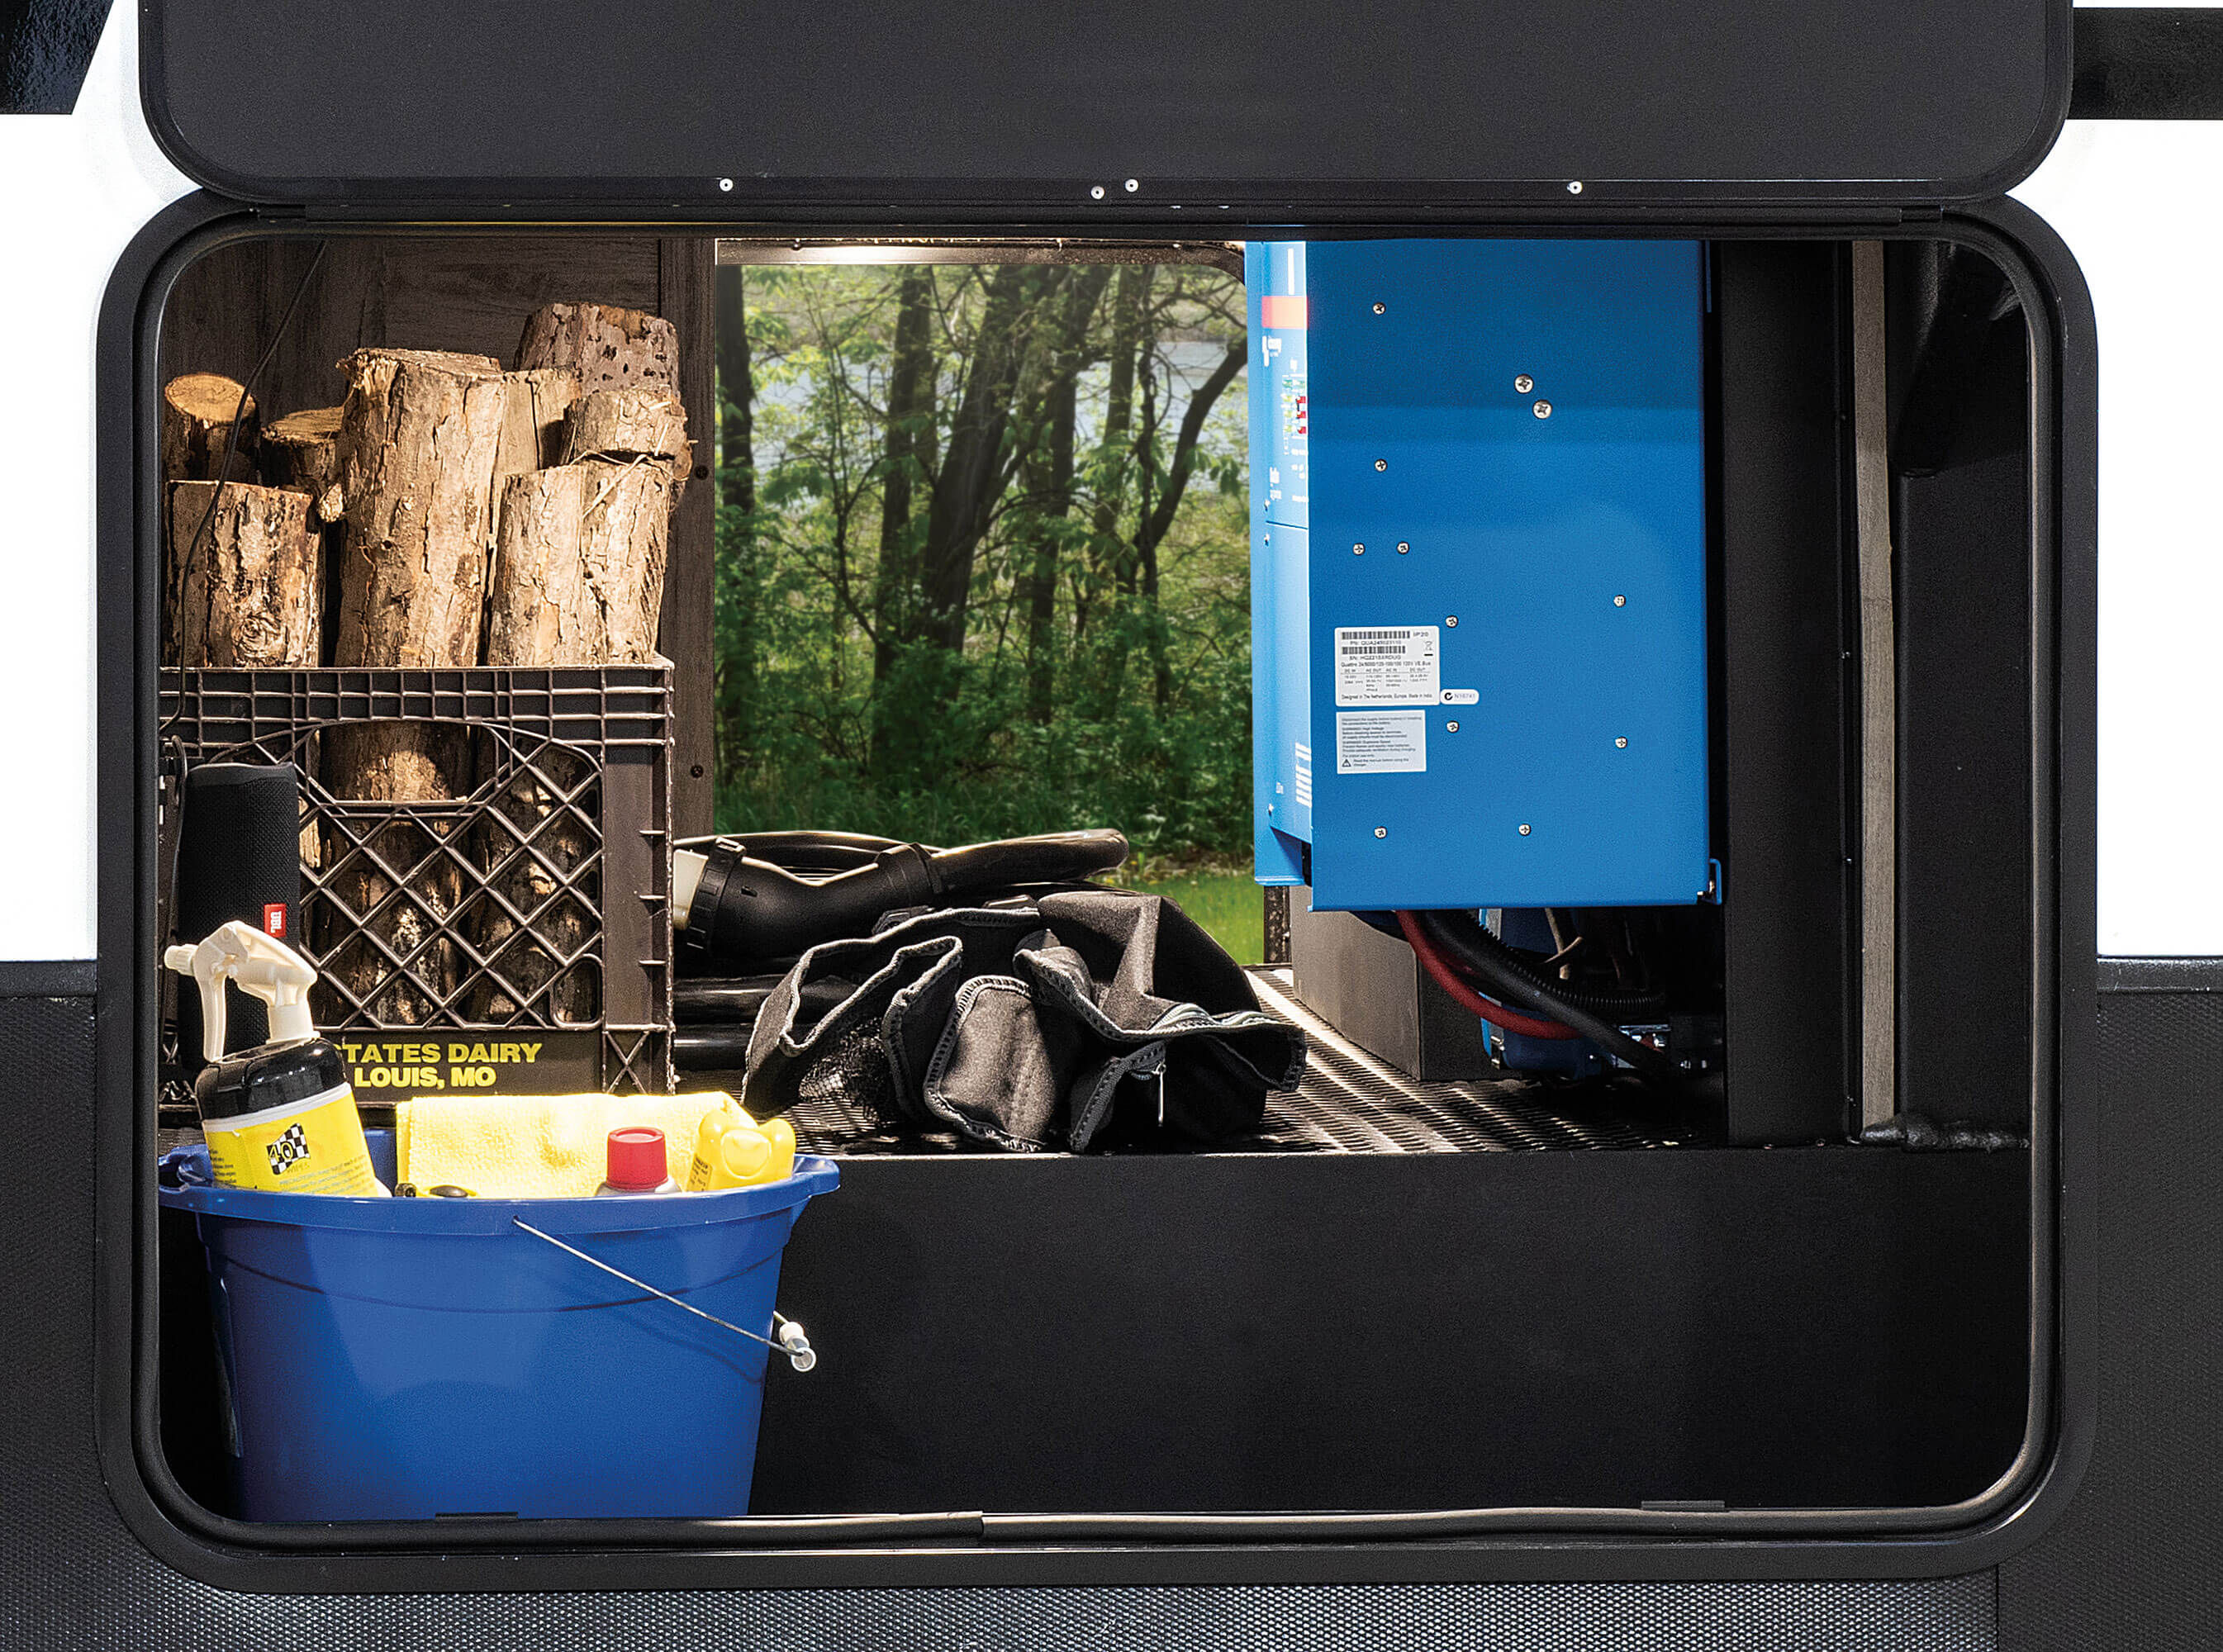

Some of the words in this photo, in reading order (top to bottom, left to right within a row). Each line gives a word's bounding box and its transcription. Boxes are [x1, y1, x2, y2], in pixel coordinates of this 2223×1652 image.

[270, 910, 282, 933] JBL
[333, 1042, 441, 1063] TATES
[448, 1042, 543, 1063] DAIRY
[354, 1066, 445, 1089] LOUIS,
[451, 1066, 497, 1087] MO
[268, 1142, 293, 1163] 40
